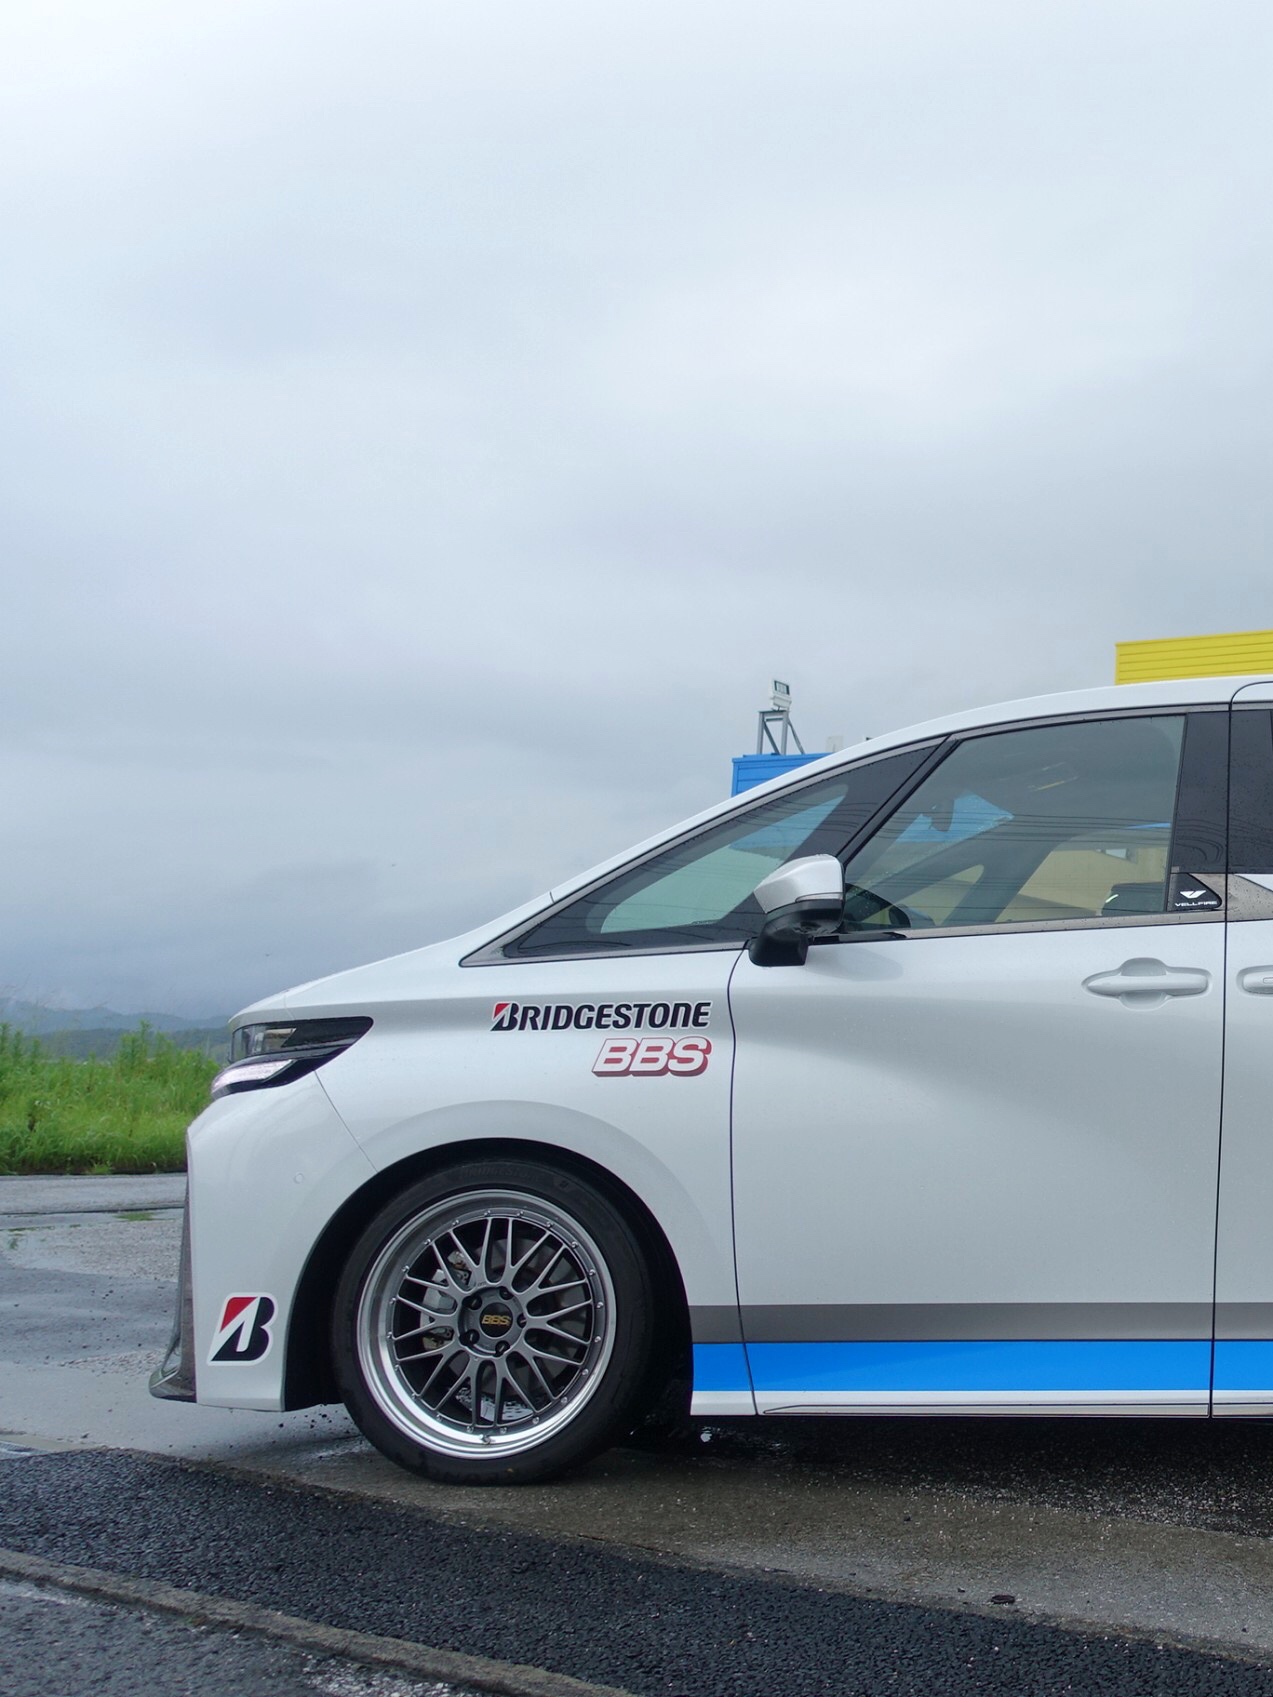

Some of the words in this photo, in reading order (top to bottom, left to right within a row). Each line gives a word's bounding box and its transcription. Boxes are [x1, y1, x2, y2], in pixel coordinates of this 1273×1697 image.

[489, 1001, 712, 1032] BRIDGESTONE
[591, 1036, 712, 1077] BBS
[482, 1314, 511, 1326] BBS
